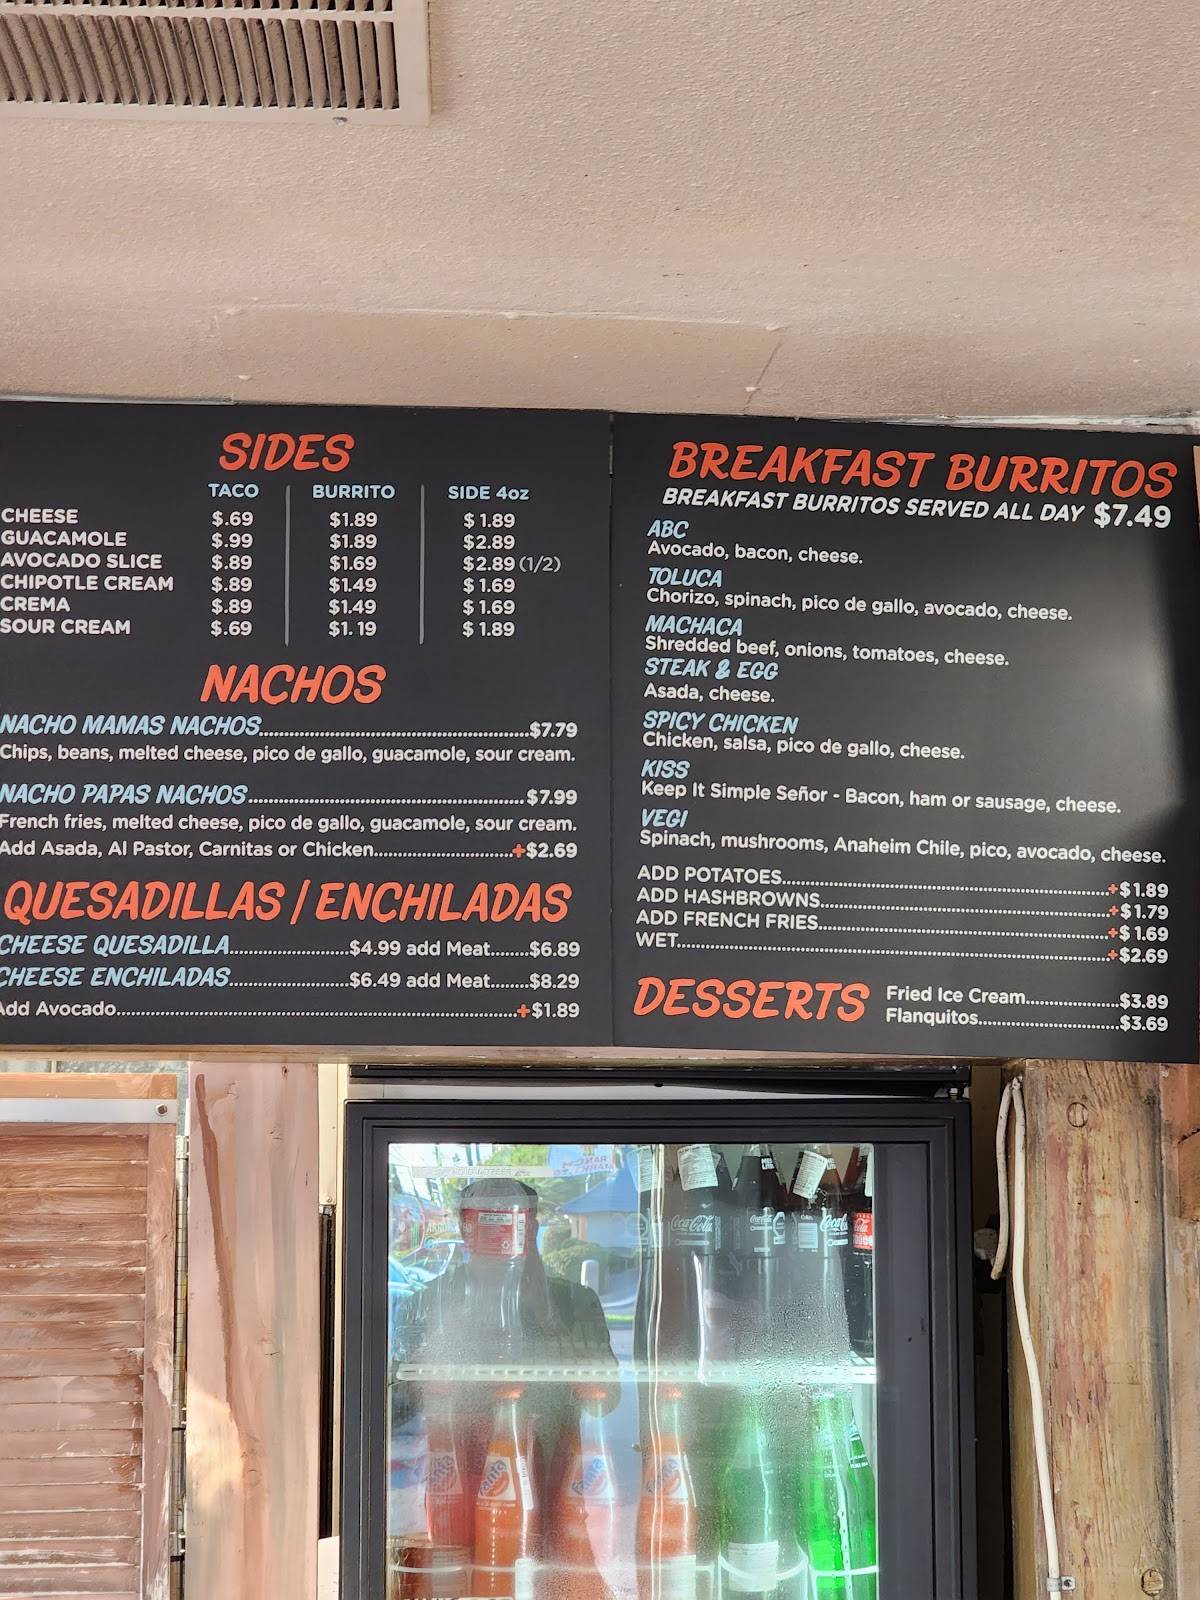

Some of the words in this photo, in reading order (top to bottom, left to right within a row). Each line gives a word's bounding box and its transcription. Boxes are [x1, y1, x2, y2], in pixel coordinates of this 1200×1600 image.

[218, 432, 355, 472] SIDES
[668, 441, 936, 488] BREAKFAST
[945, 453, 1178, 499] BURRITOS
[207, 483, 260, 498] TACO
[312, 484, 396, 499] BURRITO
[448, 485, 491, 500] SIDE
[495, 486, 530, 501] 4oz
[0, 507, 79, 524] CHEESE
[211, 510, 254, 528] $.69
[329, 511, 378, 529] $1.89
[662, 487, 790, 510] BREAKFAST
[792, 493, 901, 515] BURRITOS
[904, 498, 990, 519] SERVED
[992, 501, 1034, 521] ALL
[1039, 503, 1086, 522] DAY
[1093, 501, 1171, 529] $7.49
[0, 529, 127, 547] GUACAMOLE
[211, 532, 253, 550] $.99
[329, 533, 378, 551] $1.89
[463, 533, 516, 551] $2.89
[646, 519, 690, 540] ABC
[0, 551, 101, 569] AVOCADO
[106, 553, 162, 570] SLICE
[211, 553, 253, 572] $.89
[329, 554, 377, 573] $1.69
[463, 555, 516, 573] $2.89
[519, 555, 561, 573] (1/2)
[647, 539, 730, 561] Avocado,
[734, 543, 793, 564] bacon,
[798, 546, 863, 565] cheese.
[0, 573, 99, 591] CHIPOTLE
[103, 575, 174, 591] CREAM
[211, 575, 253, 594] $.89
[328, 576, 377, 594] $1.49
[648, 566, 723, 588] TOLUCA
[0, 595, 71, 612] CREMA
[211, 597, 252, 616] $.89
[328, 598, 377, 616] $1.49
[646, 587, 720, 608] Chorizo,
[724, 591, 797, 611] spinach,
[801, 594, 840, 612] pico
[844, 596, 867, 612] de
[871, 598, 919, 617] gallo,
[923, 601, 1002, 621] avocado,
[1007, 603, 1073, 621] cheese.
[0, 617, 56, 634] SOUR
[60, 618, 131, 635] CREAM
[210, 619, 252, 637] $.69
[644, 614, 743, 637] MACHACA
[645, 634, 731, 654] Shredded
[736, 638, 780, 658] beef,
[784, 641, 848, 661] onions,
[852, 644, 939, 665] tomatoes,
[943, 648, 1009, 666] cheese.
[644, 657, 712, 678] STEAK
[736, 661, 779, 681] EGG
[200, 664, 387, 705] NACHOS
[643, 682, 704, 703] Asada,
[708, 685, 775, 703] cheese.
[0, 713, 77, 736] NACHO
[81, 714, 166, 736] MAMAS
[529, 720, 578, 740] $7.79
[642, 709, 707, 731] SPICY
[708, 712, 799, 735] CHICKEN
[0, 743, 53, 762] Chips,
[57, 743, 114, 763] beans,
[118, 744, 179, 761] melted
[183, 744, 248, 764] cheese,
[252, 745, 290, 764] pico
[294, 745, 317, 761] de
[320, 745, 367, 764] gallo,
[371, 745, 471, 764] guacamole,
[475, 748, 514, 762] sour
[517, 749, 575, 762] cream.
[642, 730, 719, 752] Chicken,
[723, 734, 772, 754] salsa,
[776, 736, 816, 755] pico
[819, 738, 843, 755] de
[847, 740, 895, 759] gallo,
[899, 742, 965, 760] cheese.
[640, 759, 691, 780] KISS
[0, 783, 76, 805] NACHO
[81, 783, 152, 805] PAPAS
[526, 788, 578, 807] $7.99
[641, 779, 687, 800] Keep
[692, 781, 706, 798] It
[710, 782, 772, 802] Simple
[775, 784, 828, 803] Señor
[845, 787, 905, 808] Bacon,
[909, 789, 947, 807] ham
[951, 795, 971, 808] or
[975, 796, 1051, 813] sausage,
[1055, 796, 1121, 814] cheese.
[0, 813, 59, 829] French
[63, 813, 107, 832] fries,
[112, 813, 174, 830] melted
[178, 813, 244, 833] cheese,
[248, 814, 287, 833] pico
[290, 814, 313, 831] de
[317, 814, 365, 834] gallo,
[369, 814, 470, 834] guacamole,
[475, 818, 514, 831] sour
[518, 818, 577, 832] cream.
[641, 808, 689, 829] VEGI
[0, 839, 36, 856] Add
[40, 839, 103, 858] Asada,
[107, 840, 127, 856] Al
[133, 840, 194, 859] Pastor,
[198, 840, 273, 857] Carnitas
[277, 844, 298, 857] or
[639, 828, 716, 850] Spinach,
[721, 833, 829, 854] mushrooms,
[833, 836, 912, 855] Anaheim
[916, 839, 965, 859] Chile,
[969, 841, 1012, 861] pico,
[1016, 845, 1096, 864] avocado,
[1100, 846, 1167, 864] cheese.
[636, 864, 680, 882] ADD
[4, 880, 286, 926] QUESADILLAS
[315, 881, 572, 923] ENCHILADAS
[635, 908, 678, 926] ADD
[683, 910, 760, 929] FRENCH
[0, 934, 88, 956] CHEESE
[349, 939, 402, 958] $4.99
[405, 940, 441, 956] add
[529, 940, 581, 959] $6.89
[349, 971, 401, 989] $6.49
[405, 972, 441, 988] add
[529, 972, 580, 991] $8.29
[633, 976, 871, 1022] DESSERTS
[886, 985, 933, 1002] Fried
[937, 987, 964, 1003] Ice
[1119, 992, 1169, 1010] $3.89
[1119, 1014, 1169, 1032] $3.69
